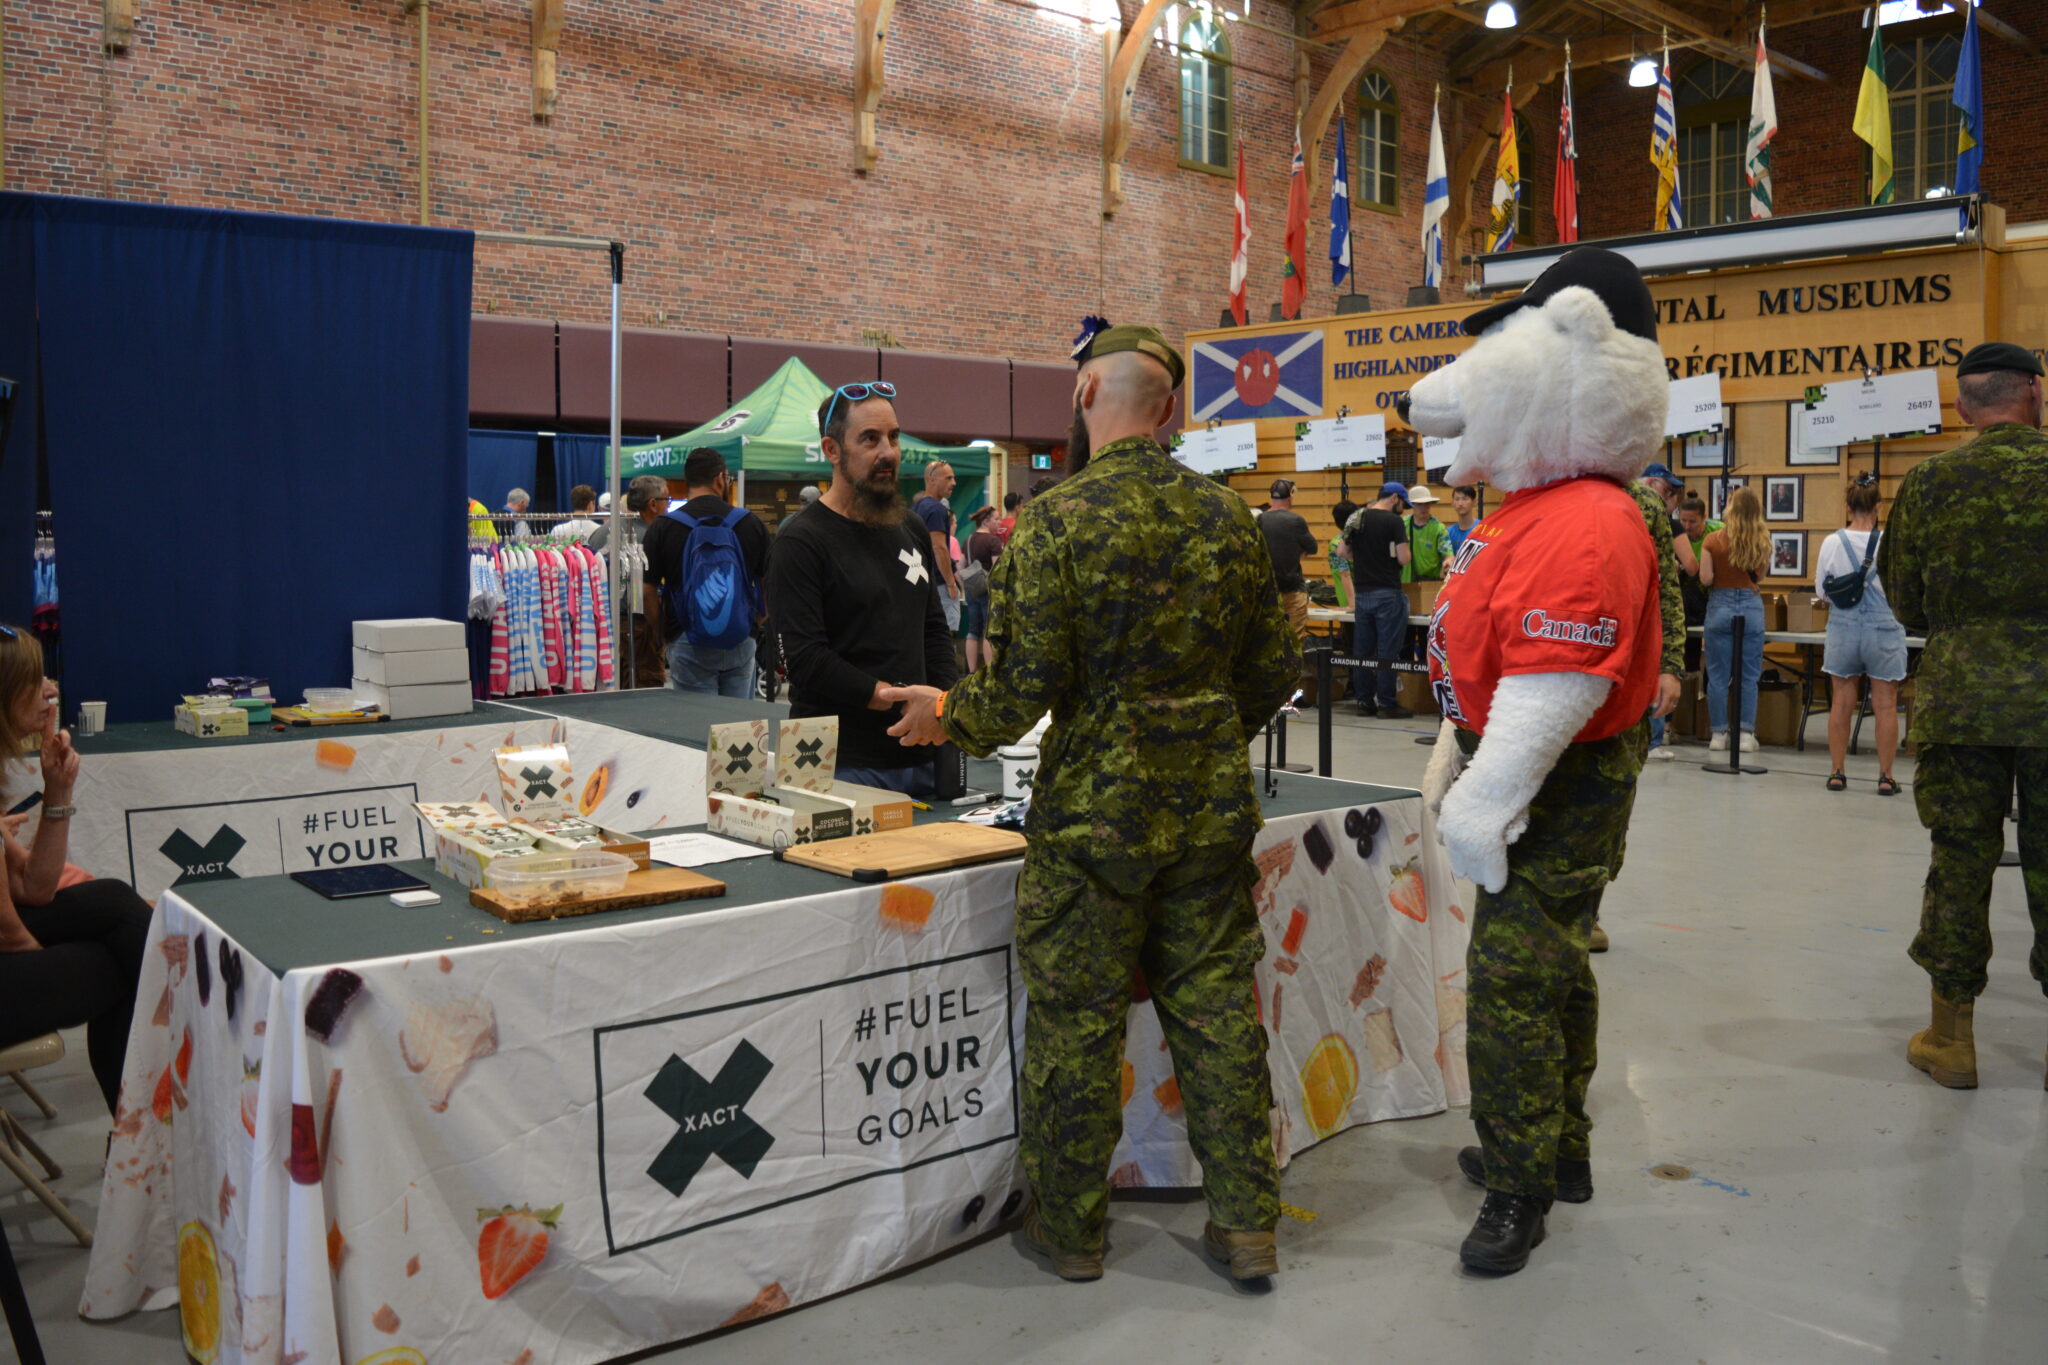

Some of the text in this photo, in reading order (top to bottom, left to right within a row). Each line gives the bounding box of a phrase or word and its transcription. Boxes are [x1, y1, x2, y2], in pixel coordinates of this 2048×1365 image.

[1655, 274, 1952, 325] TAL MUSEUMS
[1345, 327, 1383, 347] THE
[1333, 353, 1458, 379] HIGHLANDE
[1665, 338, 1963, 380] RÉGIMENTAIRES
[1694, 402, 1718, 413] 25209
[1907, 400, 1933, 411] 26497
[1811, 415, 1835, 426] 25210
[632, 447, 690, 468] SPORTST
[1522, 609, 1617, 648] Canada
[1330, 658, 1429, 672] CANADIAN ARMY ARMÉE CANA
[303, 806, 397, 834] #FUEL
[305, 836, 399, 867] YOUR
[186, 862, 225, 876] XACT
[855, 986, 981, 1042] #FUEL
[855, 1035, 981, 1096] YOUR
[683, 1104, 739, 1134] XACT
[857, 1088, 984, 1147] GOALS
